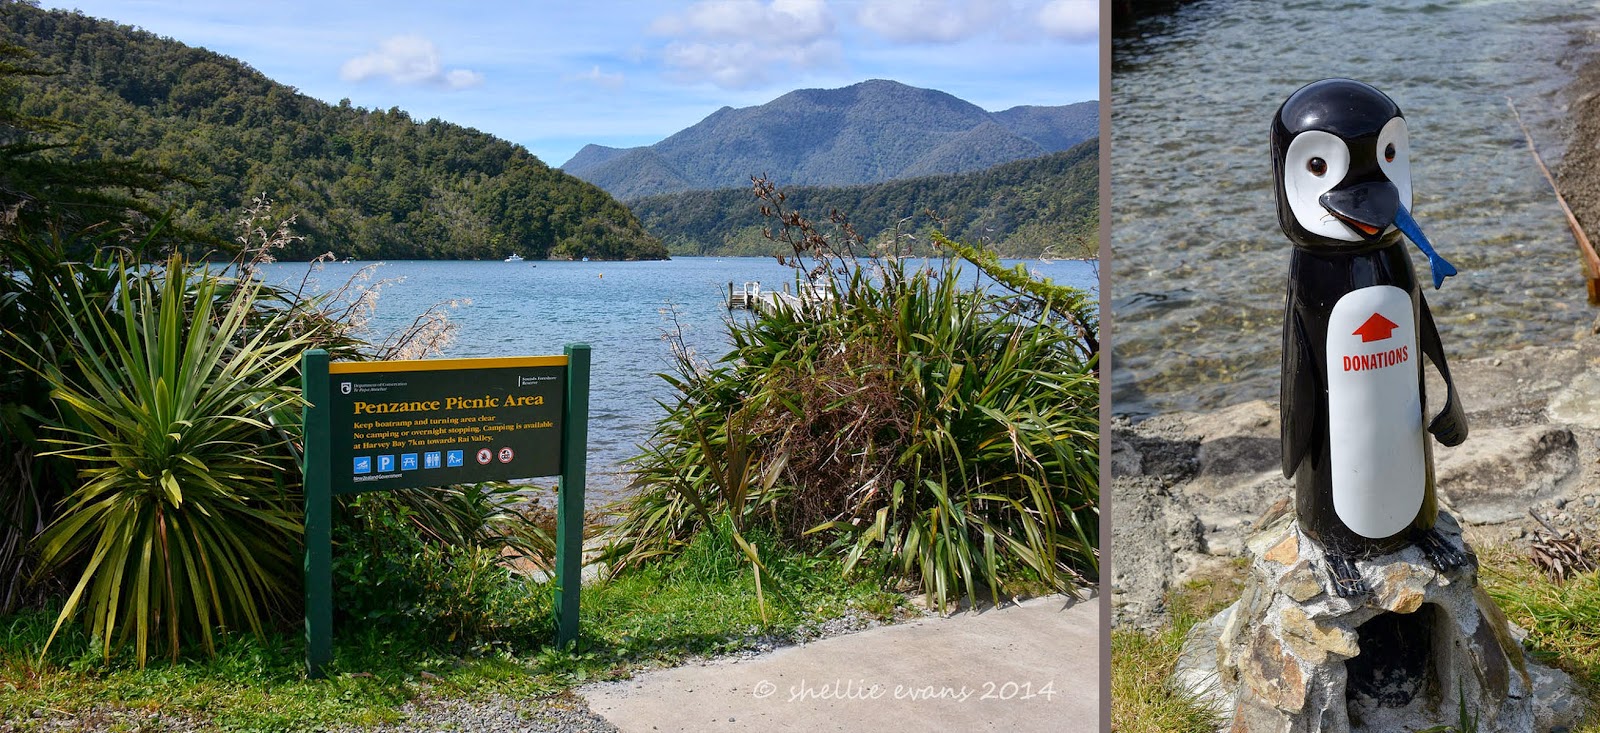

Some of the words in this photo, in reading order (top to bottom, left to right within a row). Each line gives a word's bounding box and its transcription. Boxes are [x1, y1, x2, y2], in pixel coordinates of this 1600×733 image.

[1343, 345, 1409, 372] DONATIONS
[353, 401, 440, 415] Penzance
[445, 395, 500, 410] Picnic
[503, 394, 545, 407] Area
[353, 422, 374, 430] Keep
[375, 420, 413, 428] boatramp
[366, 430, 399, 439] camping
[411, 428, 447, 436] overnight
[448, 426, 481, 434] stopping.
[483, 424, 514, 432] Camping
[523, 421, 553, 429] available
[363, 440, 390, 449] Harvey
[392, 439, 406, 448] Bay
